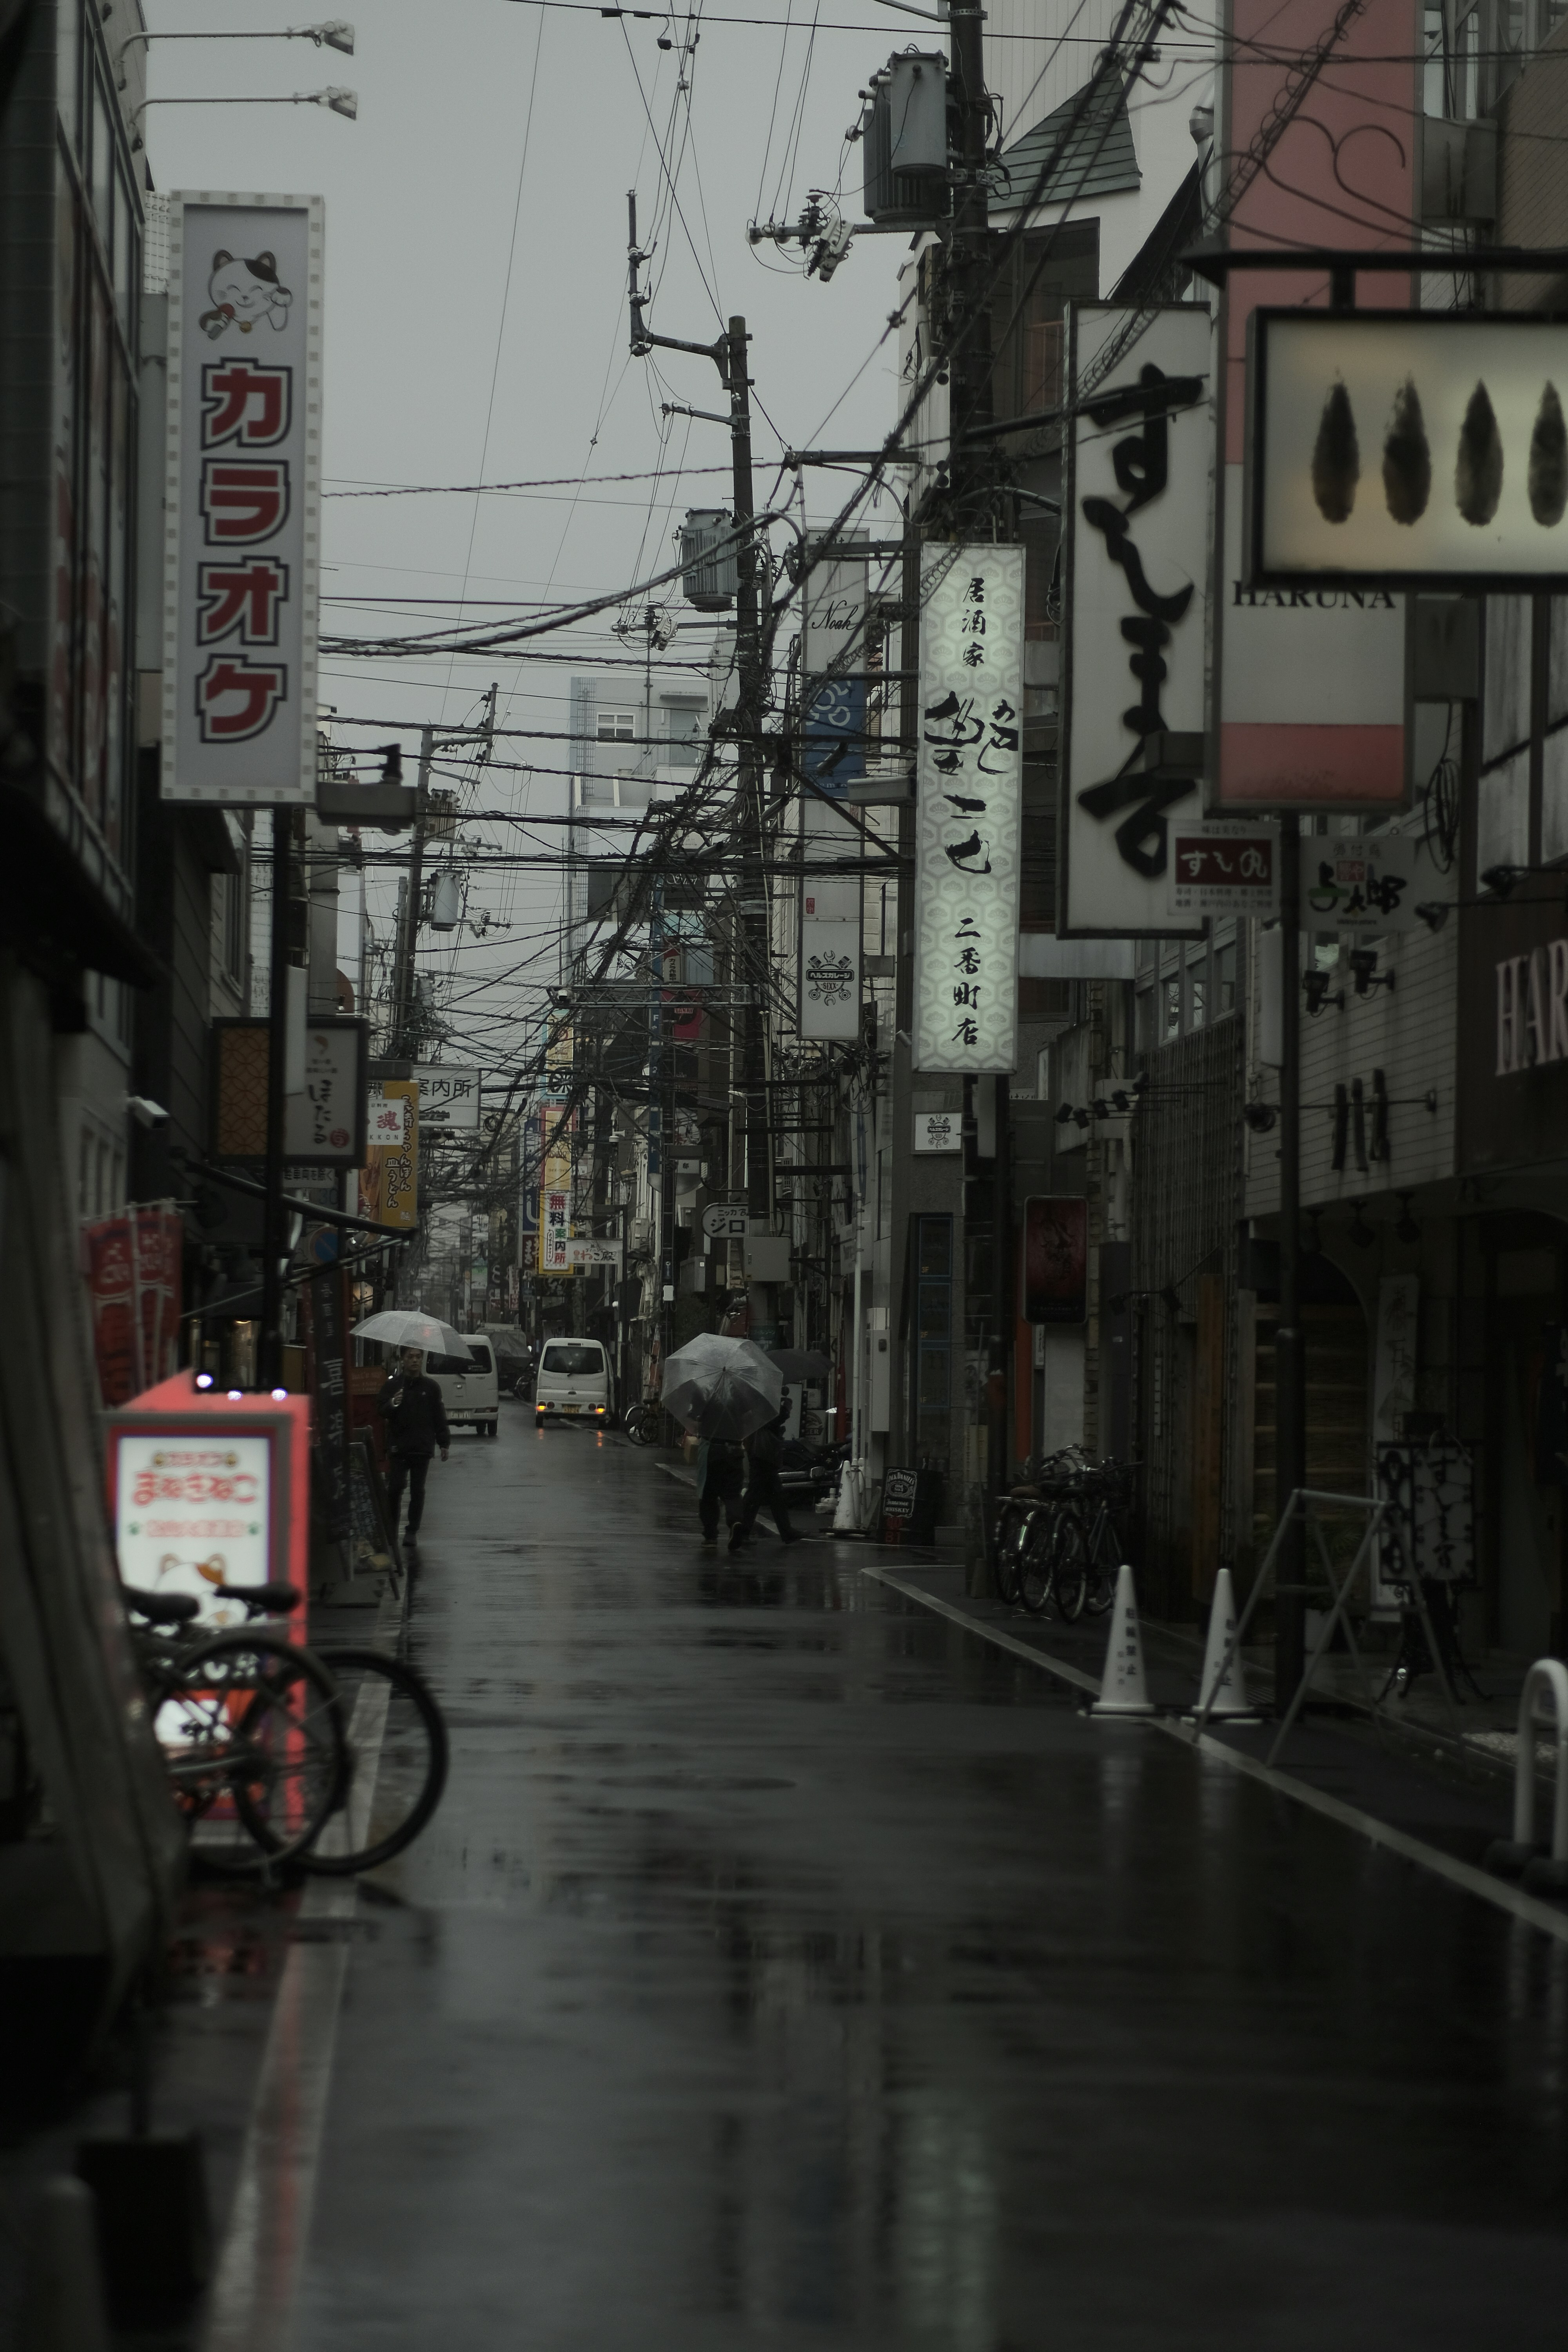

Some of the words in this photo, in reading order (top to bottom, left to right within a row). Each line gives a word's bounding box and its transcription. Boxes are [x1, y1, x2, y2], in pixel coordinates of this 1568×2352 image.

[197, 357, 292, 744] カラオケ
[812, 600, 858, 630] Noah
[962, 578, 986, 666] 居酒家
[951, 918, 981, 1045] 二番町店
[385, 1157, 399, 1209] 皿うどん
[550, 1194, 566, 1264] 無料案内所
[132, 1470, 258, 1507] まねきねこ
